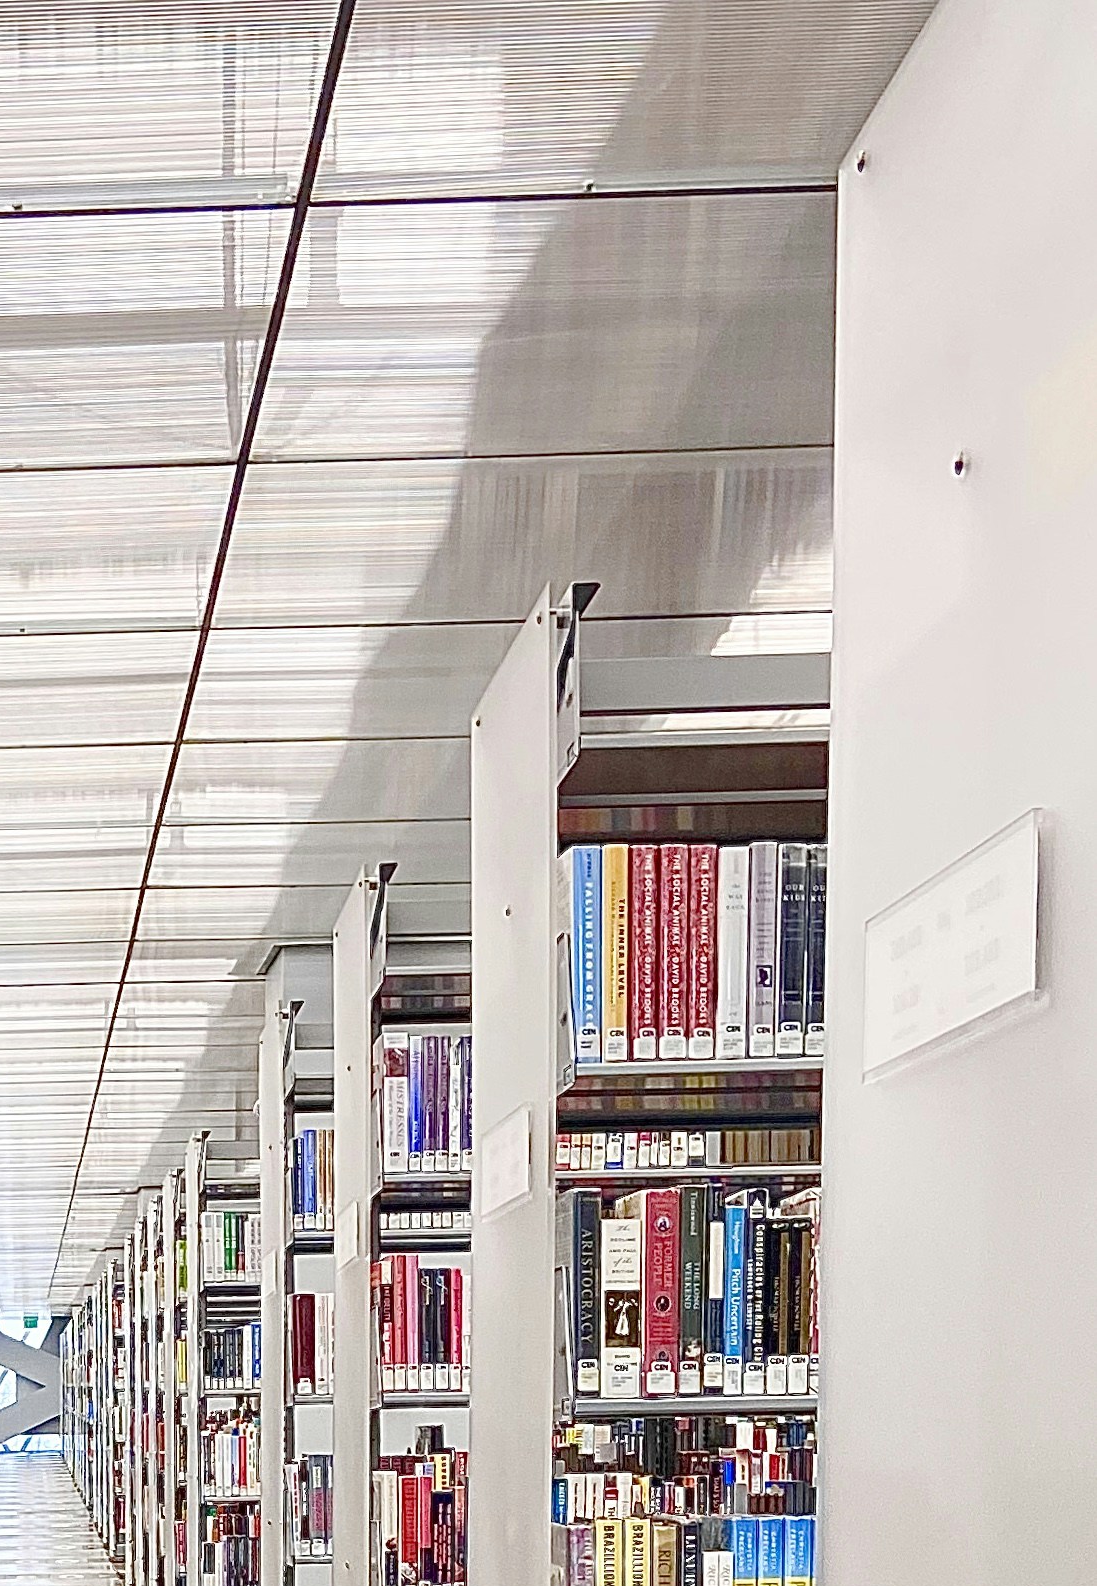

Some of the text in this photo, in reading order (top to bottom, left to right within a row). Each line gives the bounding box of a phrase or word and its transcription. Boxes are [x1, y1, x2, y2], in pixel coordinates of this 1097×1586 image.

[585, 882, 593, 939] FALLING
[643, 854, 652, 1025] THE SOCIAL ANIMAL DAVID BROOKS
[672, 854, 681, 1025] THE SOCIAL ANIMAL DAVID BROOKS
[700, 854, 709, 1025] THE SOCIAL ANIMAL DAVID BROOKS
[585, 944, 593, 980] FROM
[396, 1080, 404, 1148] MISTRESSES
[581, 1228, 593, 1343] ARISTOCRACY
[653, 1243, 662, 1284] PEOPLE
[664, 1240, 673, 1287] FORMER
[684, 1262, 692, 1309] WEEKEND
[753, 1225, 765, 1287] Conspiracies
[693, 1262, 701, 1310] THE LONG
[730, 1268, 740, 1345] Pitch Uncertain
[658, 1550, 672, 1585] RICH
